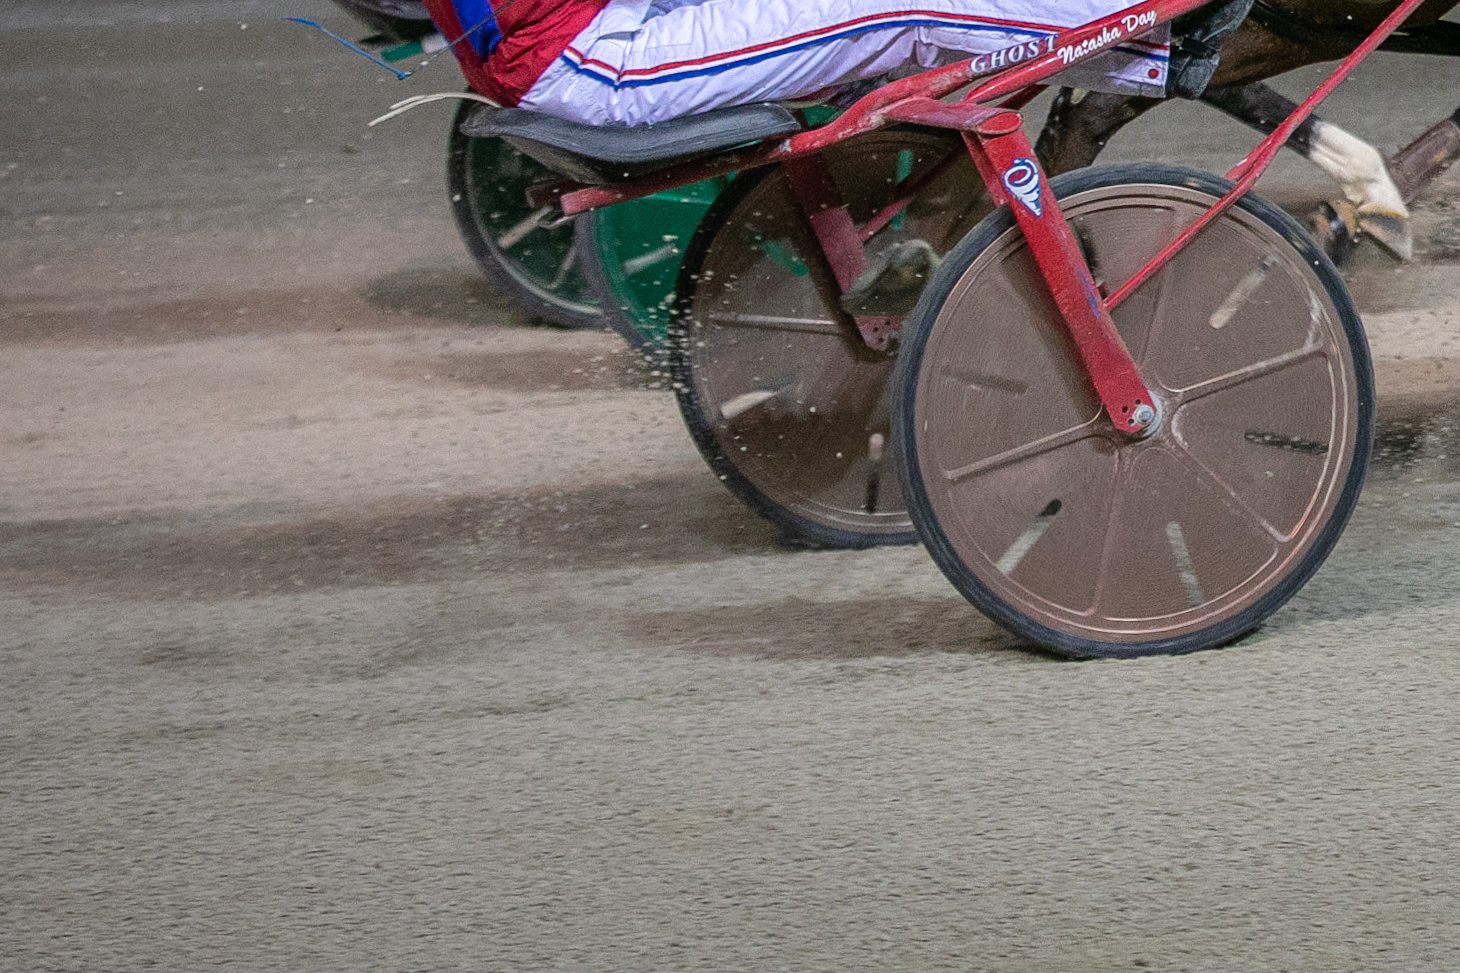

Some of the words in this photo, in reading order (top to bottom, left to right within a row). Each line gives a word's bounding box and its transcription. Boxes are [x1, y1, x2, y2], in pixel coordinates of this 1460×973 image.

[969, 34, 1060, 74] GHOST
[1057, 27, 1121, 65] Natasha
[1121, 10, 1158, 32] Day
